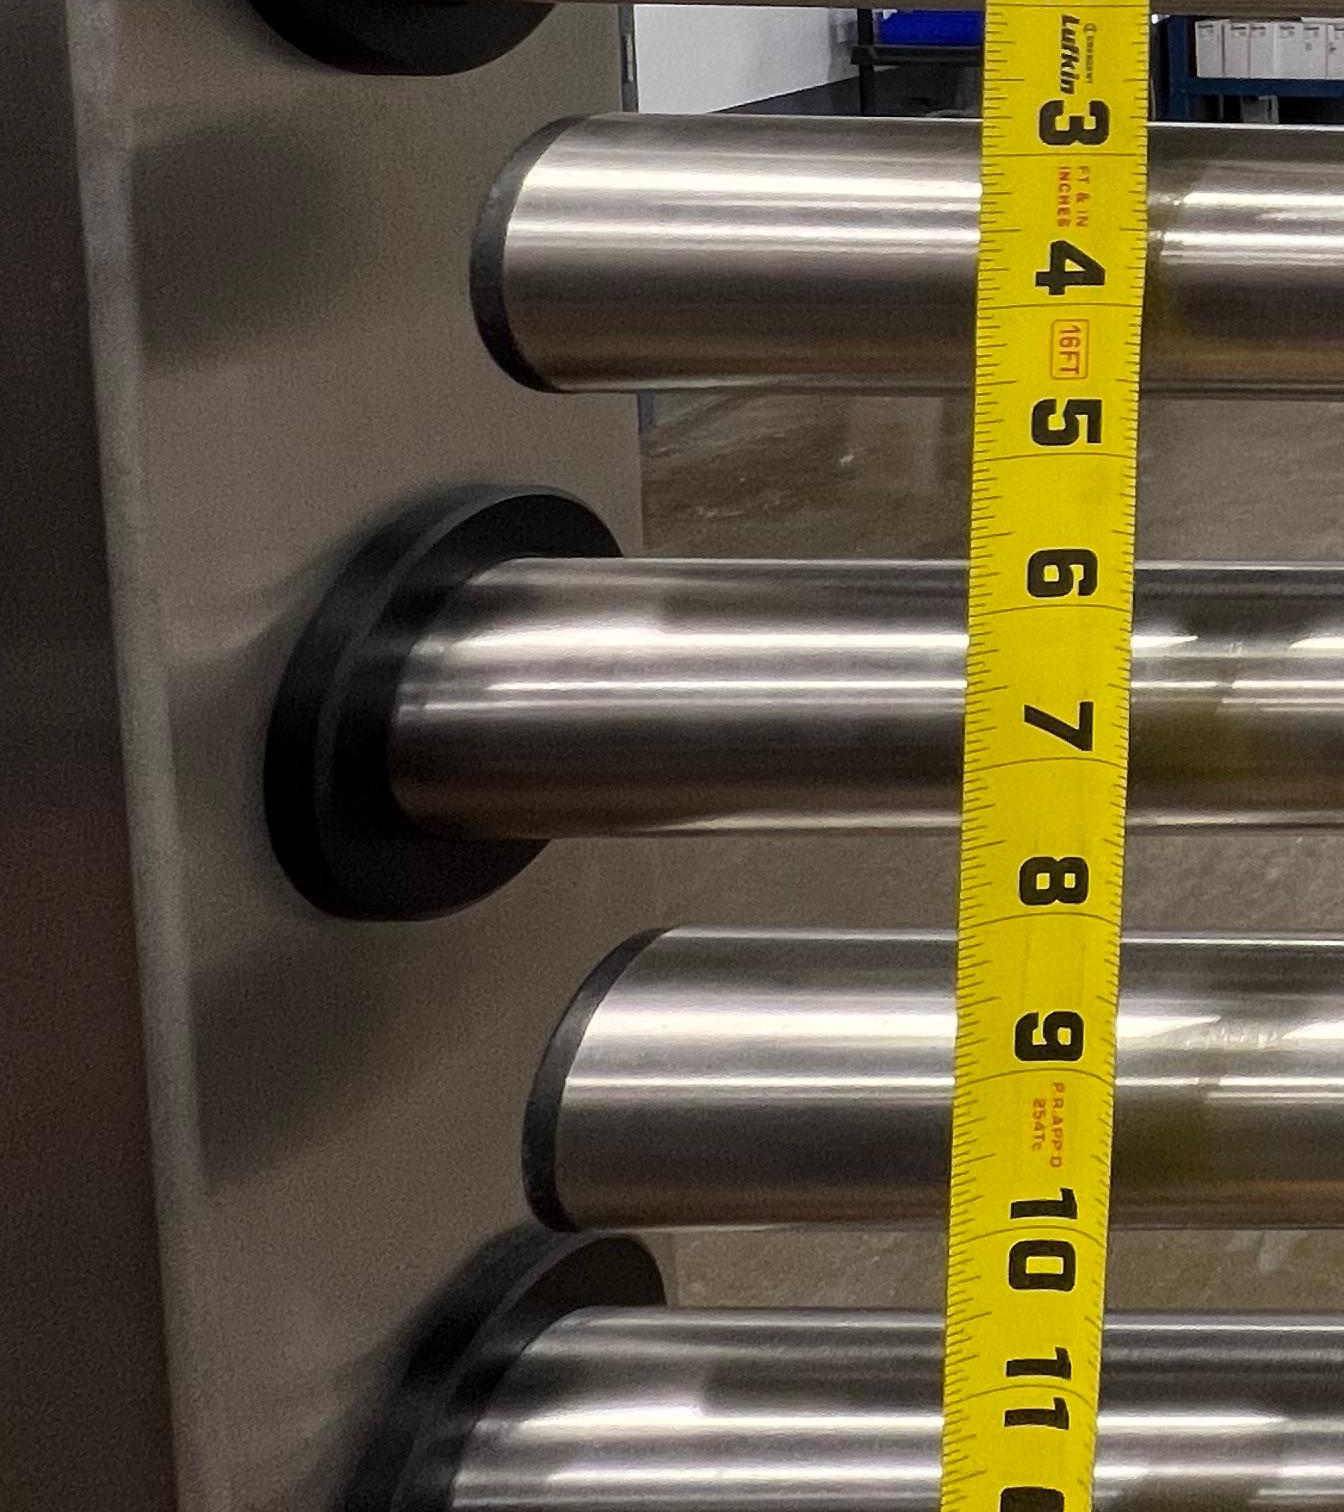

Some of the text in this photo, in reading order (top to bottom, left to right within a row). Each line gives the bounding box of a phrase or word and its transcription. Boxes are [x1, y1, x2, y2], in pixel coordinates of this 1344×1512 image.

[1059, 14, 1081, 95] Lufkin
[1038, 99, 1110, 146] 3
[1057, 166, 1072, 228] INCHES
[1077, 165, 1090, 184] FT
[1075, 210, 1089, 228] IN
[1035, 240, 1106, 296] 4
[1058, 324, 1081, 375] 16FT
[1031, 398, 1102, 447] 5
[1026, 548, 1098, 598] 6
[1023, 701, 1094, 752] 7
[1018, 856, 1089, 906] 8
[1014, 1011, 1084, 1062] 9
[1008, 1187, 1078, 1292] 10
[1004, 1347, 1072, 1431] 11
